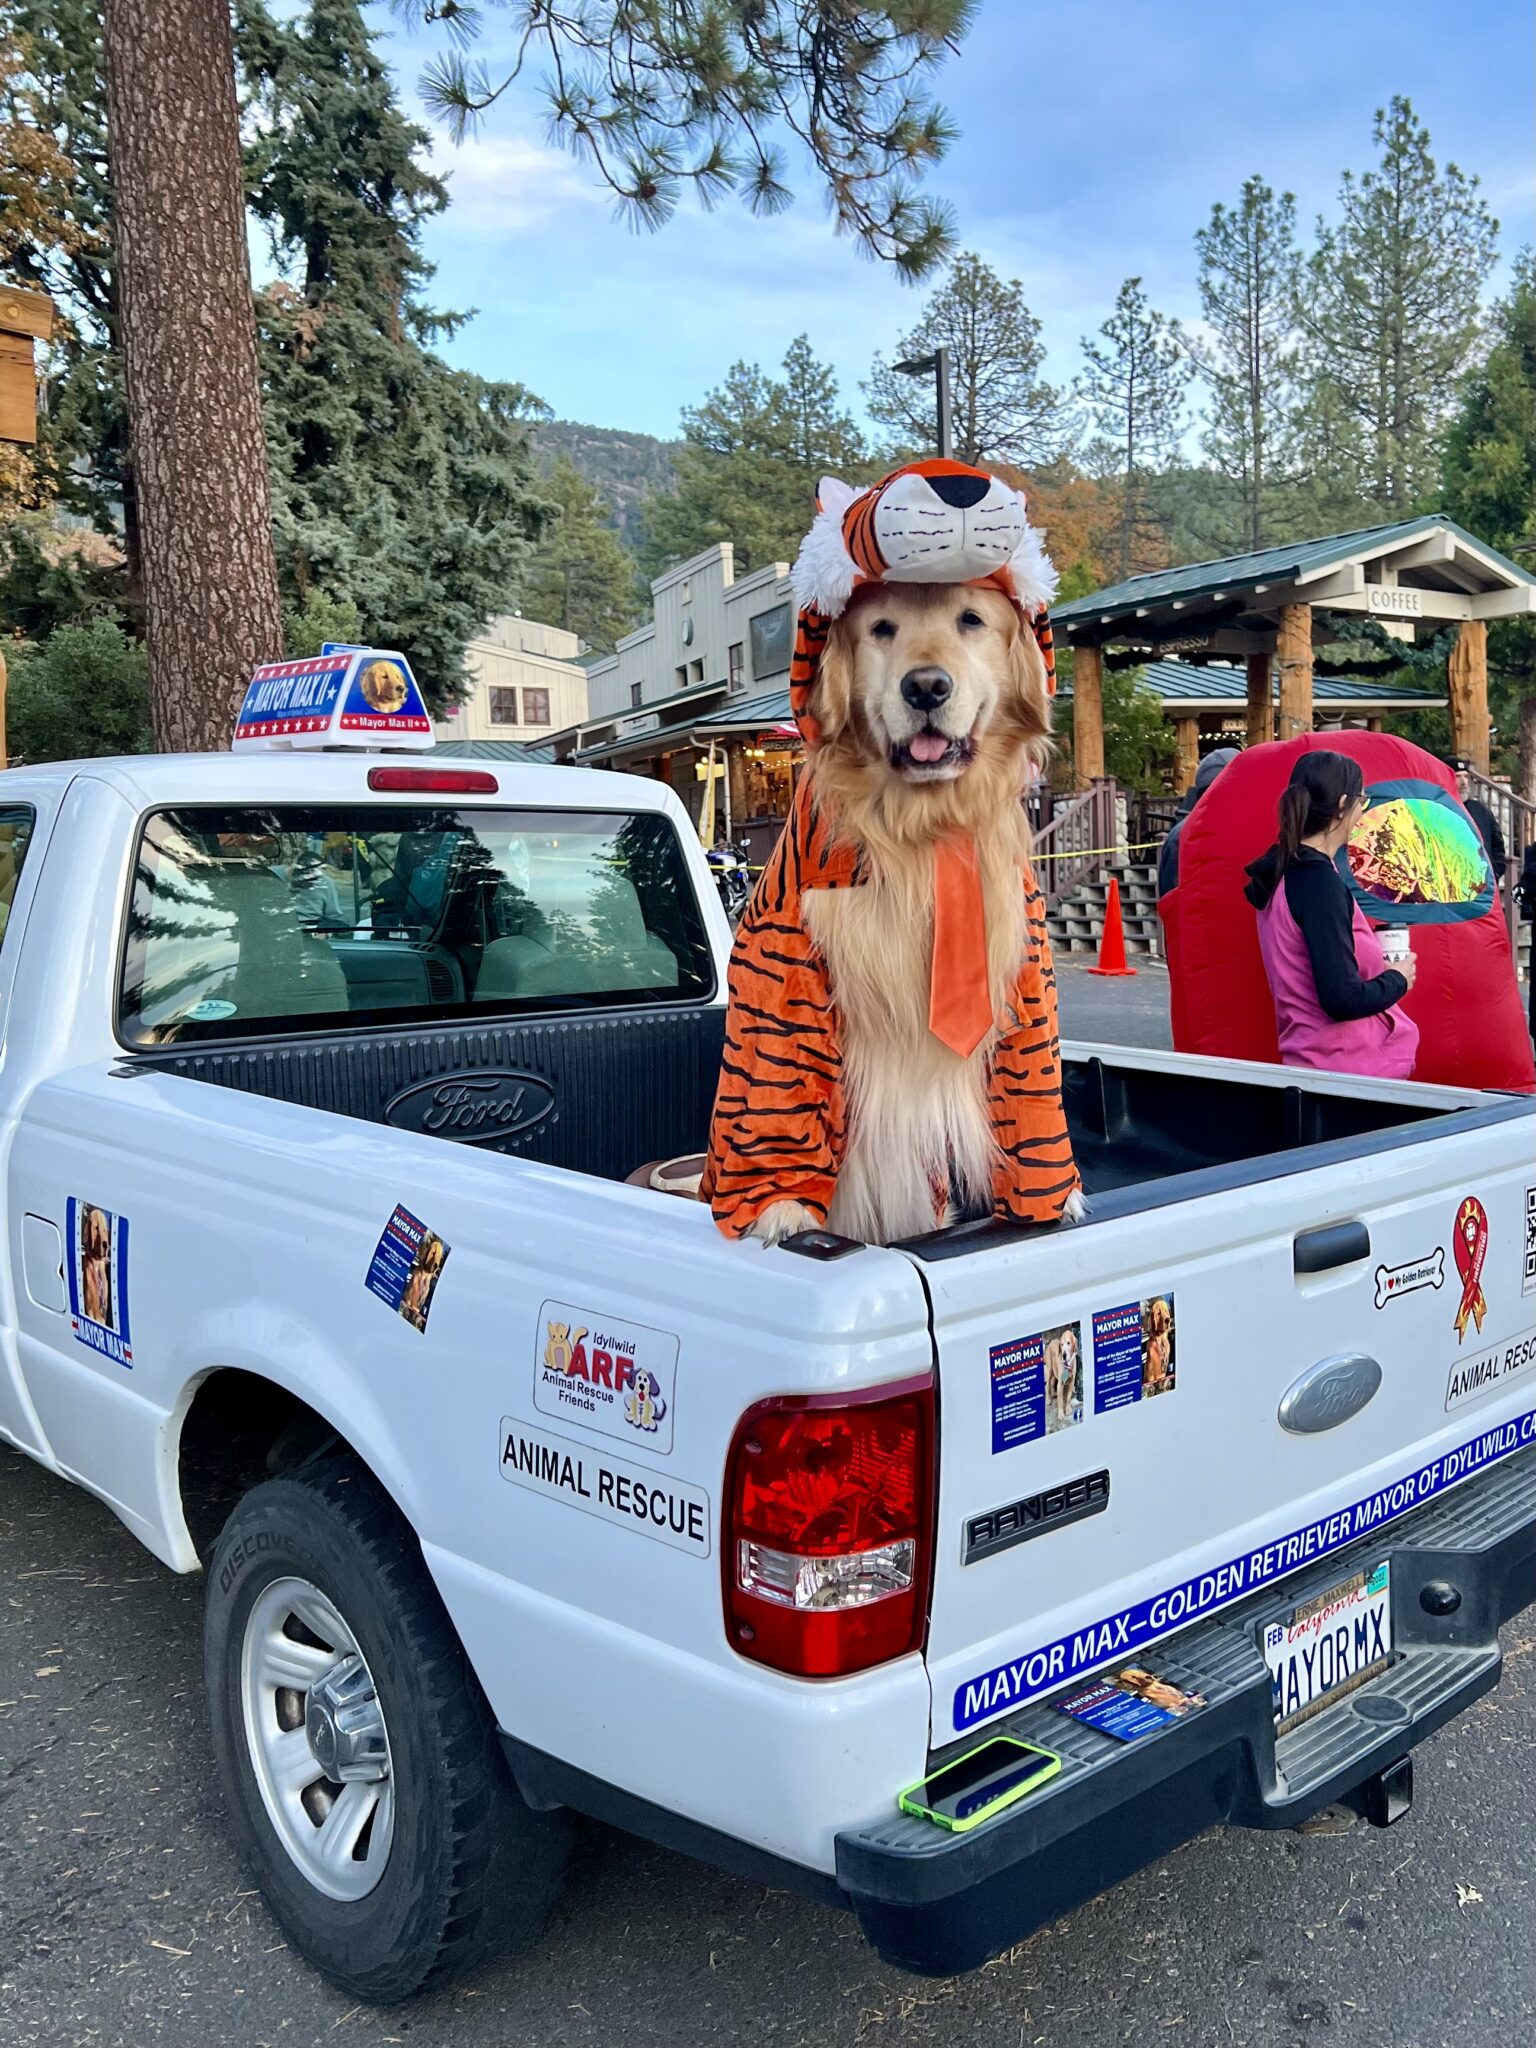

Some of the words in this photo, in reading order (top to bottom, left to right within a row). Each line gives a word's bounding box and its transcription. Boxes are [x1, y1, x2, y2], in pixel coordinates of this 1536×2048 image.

[1371, 590, 1419, 611] COFFEE
[252, 678, 295, 713] MAYOR
[289, 674, 322, 709] MAX
[315, 673, 332, 706] II
[359, 717, 386, 729] Mayor
[388, 717, 406, 728] Max
[407, 718, 414, 729] II
[422, 1079, 526, 1130] Ford
[391, 1214, 411, 1234] MAYOR
[408, 1228, 422, 1243] MAX
[77, 1317, 106, 1352] MAYOR
[105, 1332, 126, 1363] MAX
[1096, 1319, 1123, 1335] MAYOR
[1123, 1314, 1139, 1327] MAX
[593, 1331, 636, 1356] Idyllwild
[994, 1350, 1022, 1369] MAYOR
[1023, 1345, 1041, 1360] MAX
[567, 1343, 635, 1393] ARF
[1448, 1355, 1500, 1401] ANIMAL
[542, 1370, 576, 1391] Animal
[577, 1381, 614, 1404] Rescue
[558, 1389, 596, 1412] Friends
[502, 1433, 591, 1498] ANIMAL
[599, 1467, 704, 1542] RESCUE
[968, 1472, 1110, 1547] RANGER
[964, 1644, 1066, 1719] MAYOR
[1249, 1514, 1351, 1583] RETRIEVER
[1354, 1478, 1416, 1532] MAYOR
[1418, 1463, 1440, 1495] OF
[1442, 1423, 1519, 1483] IDYLLWILD,
[1297, 1598, 1321, 1620] ERNIE
[1323, 1575, 1363, 1605] MAXWELL
[1267, 1626, 1284, 1649] FEB
[1063, 1692, 1095, 1711] MAYOR
[1093, 1685, 1113, 1698] MAX
